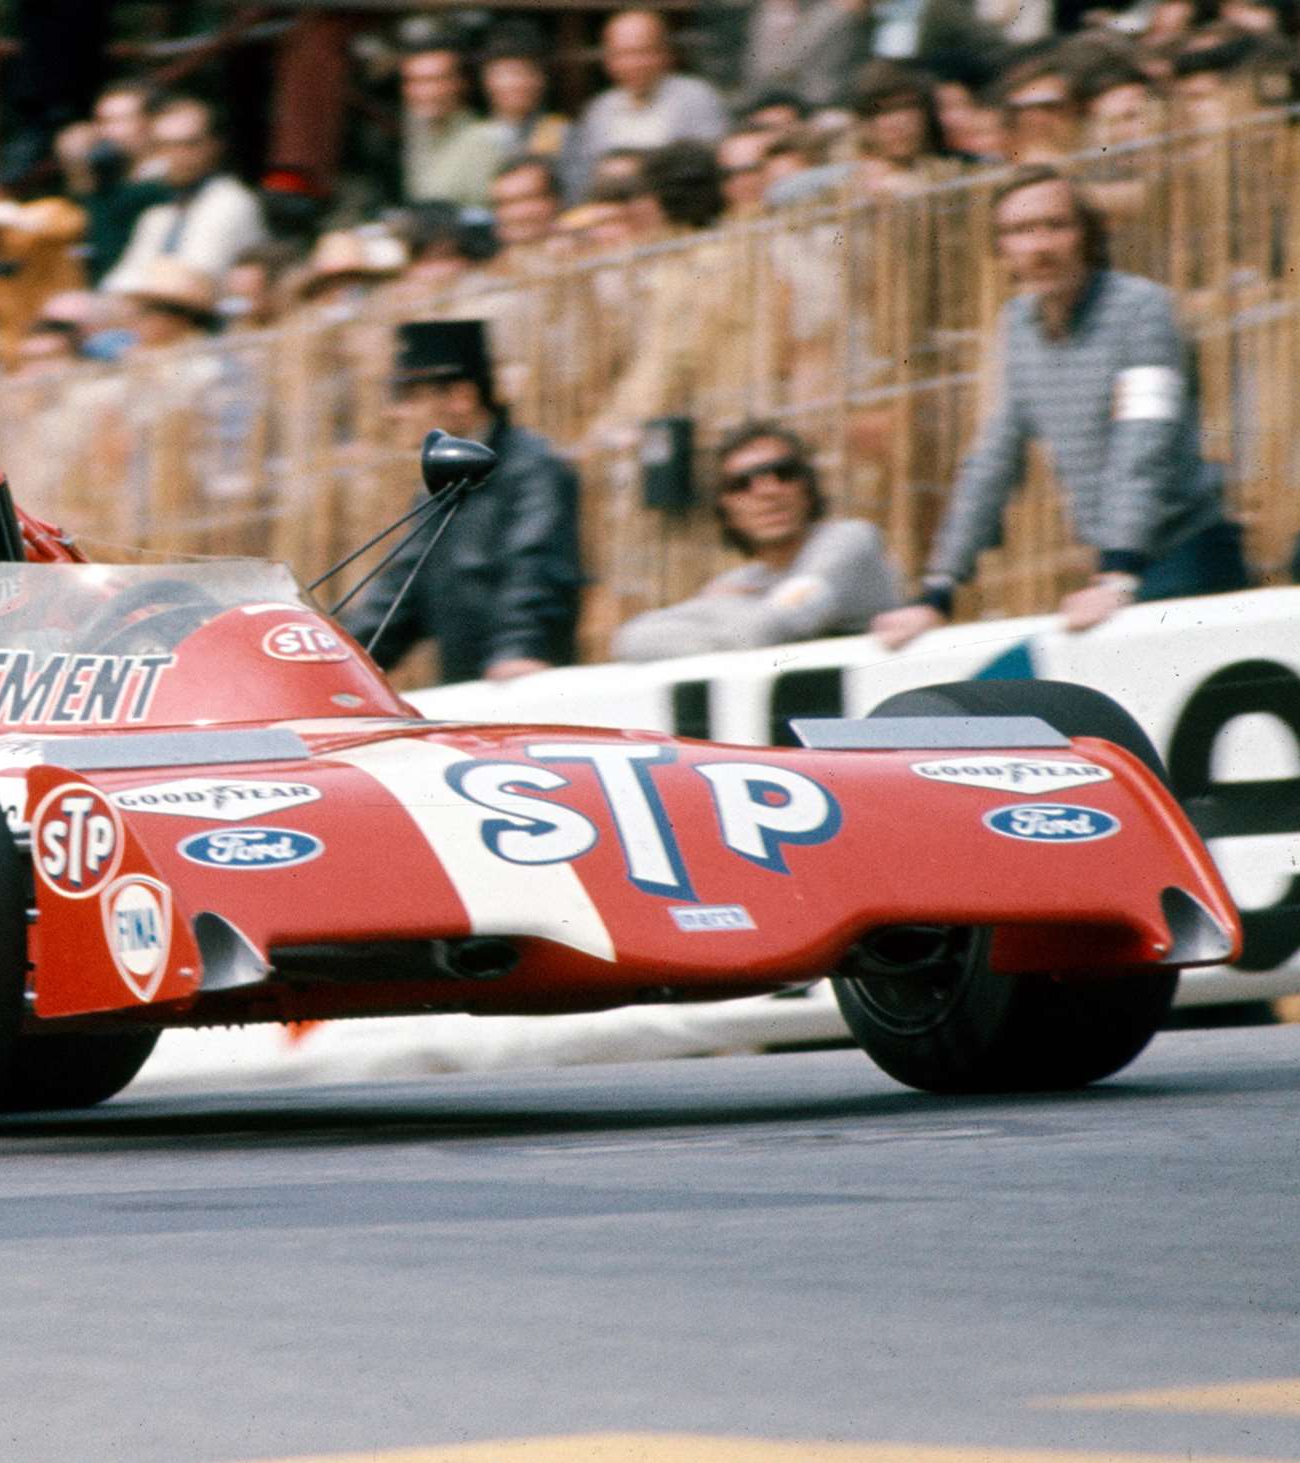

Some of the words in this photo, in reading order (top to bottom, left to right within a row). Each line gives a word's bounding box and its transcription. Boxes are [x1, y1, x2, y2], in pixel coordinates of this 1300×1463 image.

[274, 624, 338, 653] STP
[918, 762, 1104, 784] GOODYEAR
[118, 784, 314, 810] GOODYEAR
[443, 742, 844, 902] STP
[1010, 807, 1096, 836] Ford
[43, 797, 115, 887] STP
[206, 831, 300, 862] Ford
